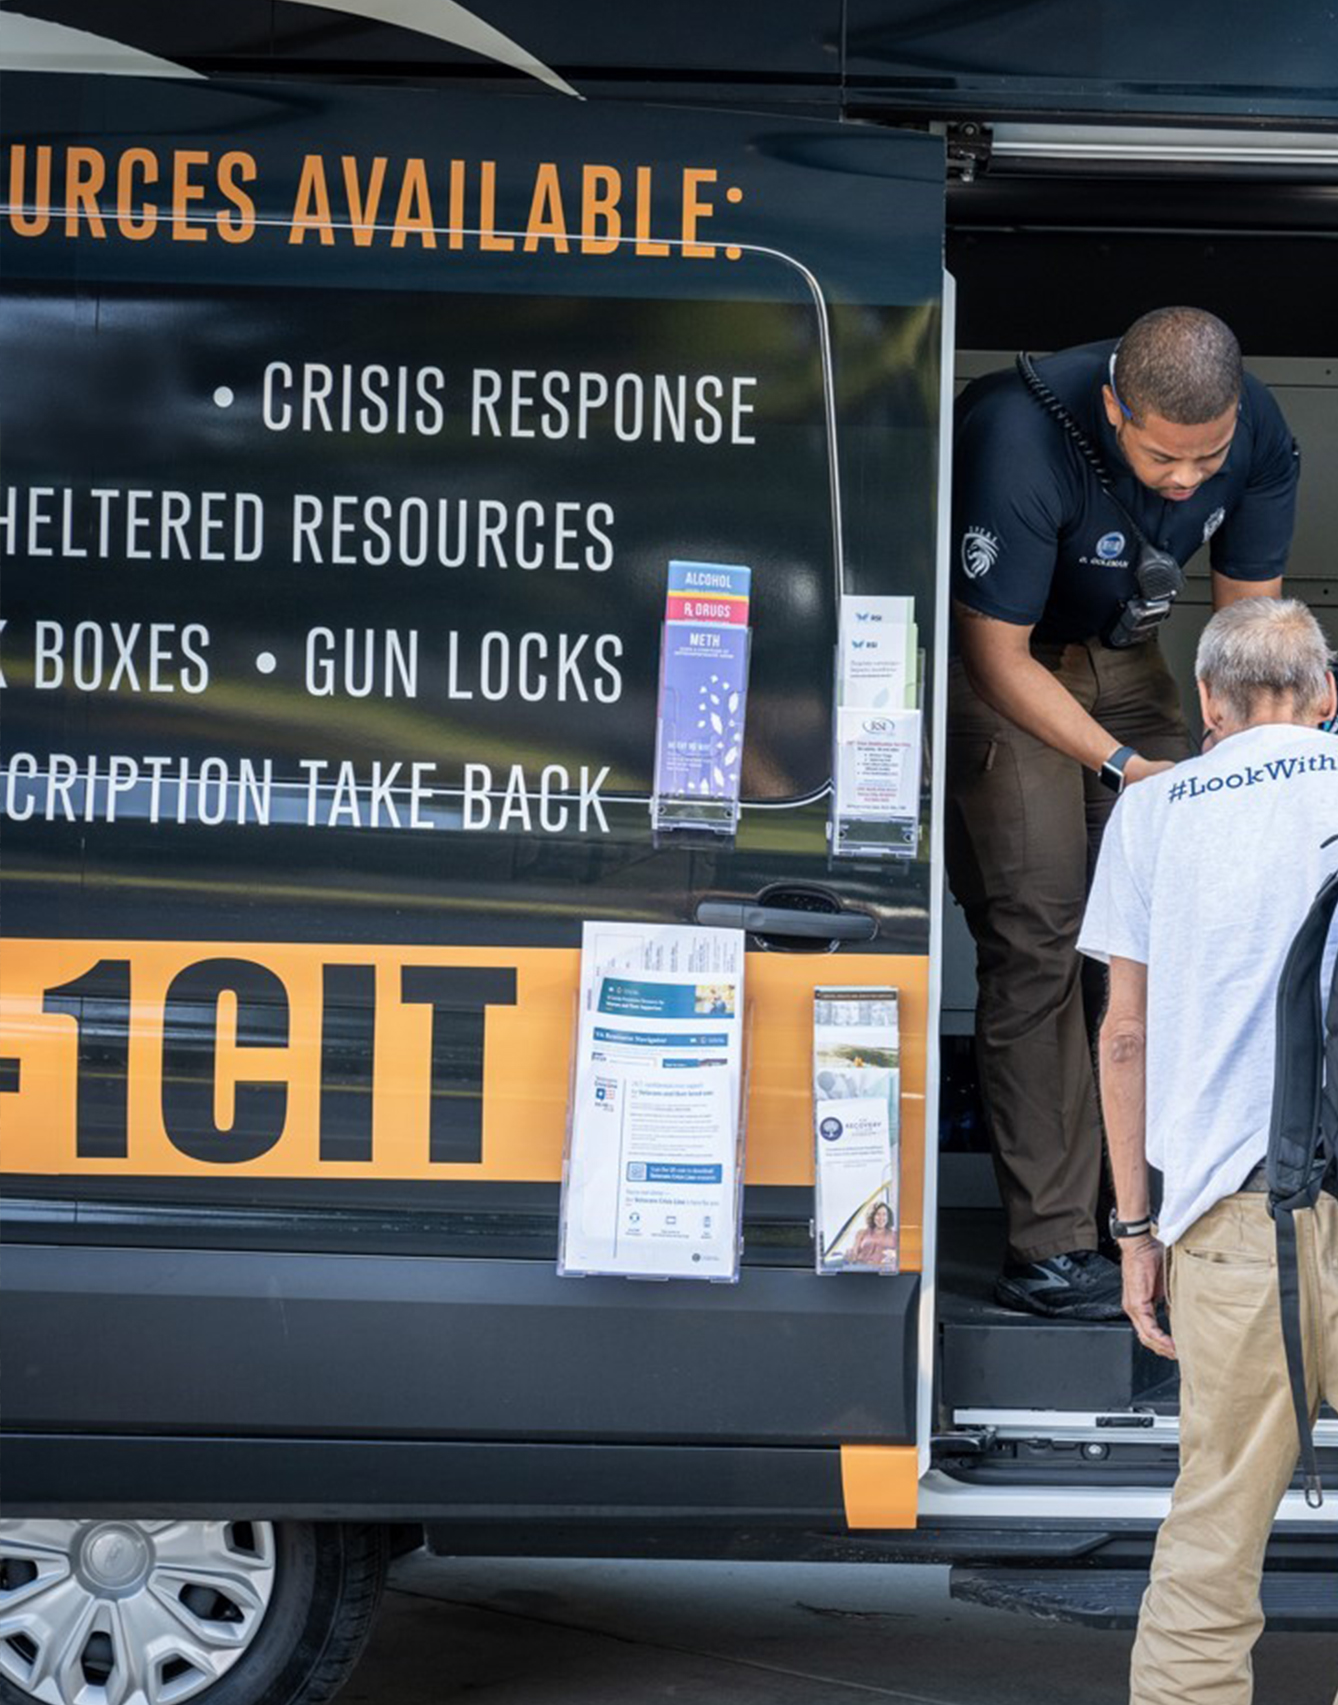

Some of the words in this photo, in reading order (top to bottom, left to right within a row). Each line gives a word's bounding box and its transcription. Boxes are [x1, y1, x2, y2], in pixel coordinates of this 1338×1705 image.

[10, 145, 258, 244] URCES
[289, 154, 743, 260] AVAILABLE:
[263, 362, 445, 435] CRISIS
[471, 369, 757, 445] RESPONSE
[293, 494, 614, 572] RESOURCES
[684, 571, 732, 588] ALCOHOL
[695, 602, 731, 618] DRUGS
[35, 620, 210, 694] BOXES
[305, 626, 418, 698] GUN
[448, 630, 624, 703] LOCKS
[689, 632, 721, 648] METH
[6, 752, 272, 827] CRIPTION
[299, 760, 438, 829] TAKE
[461, 764, 611, 833] BACK
